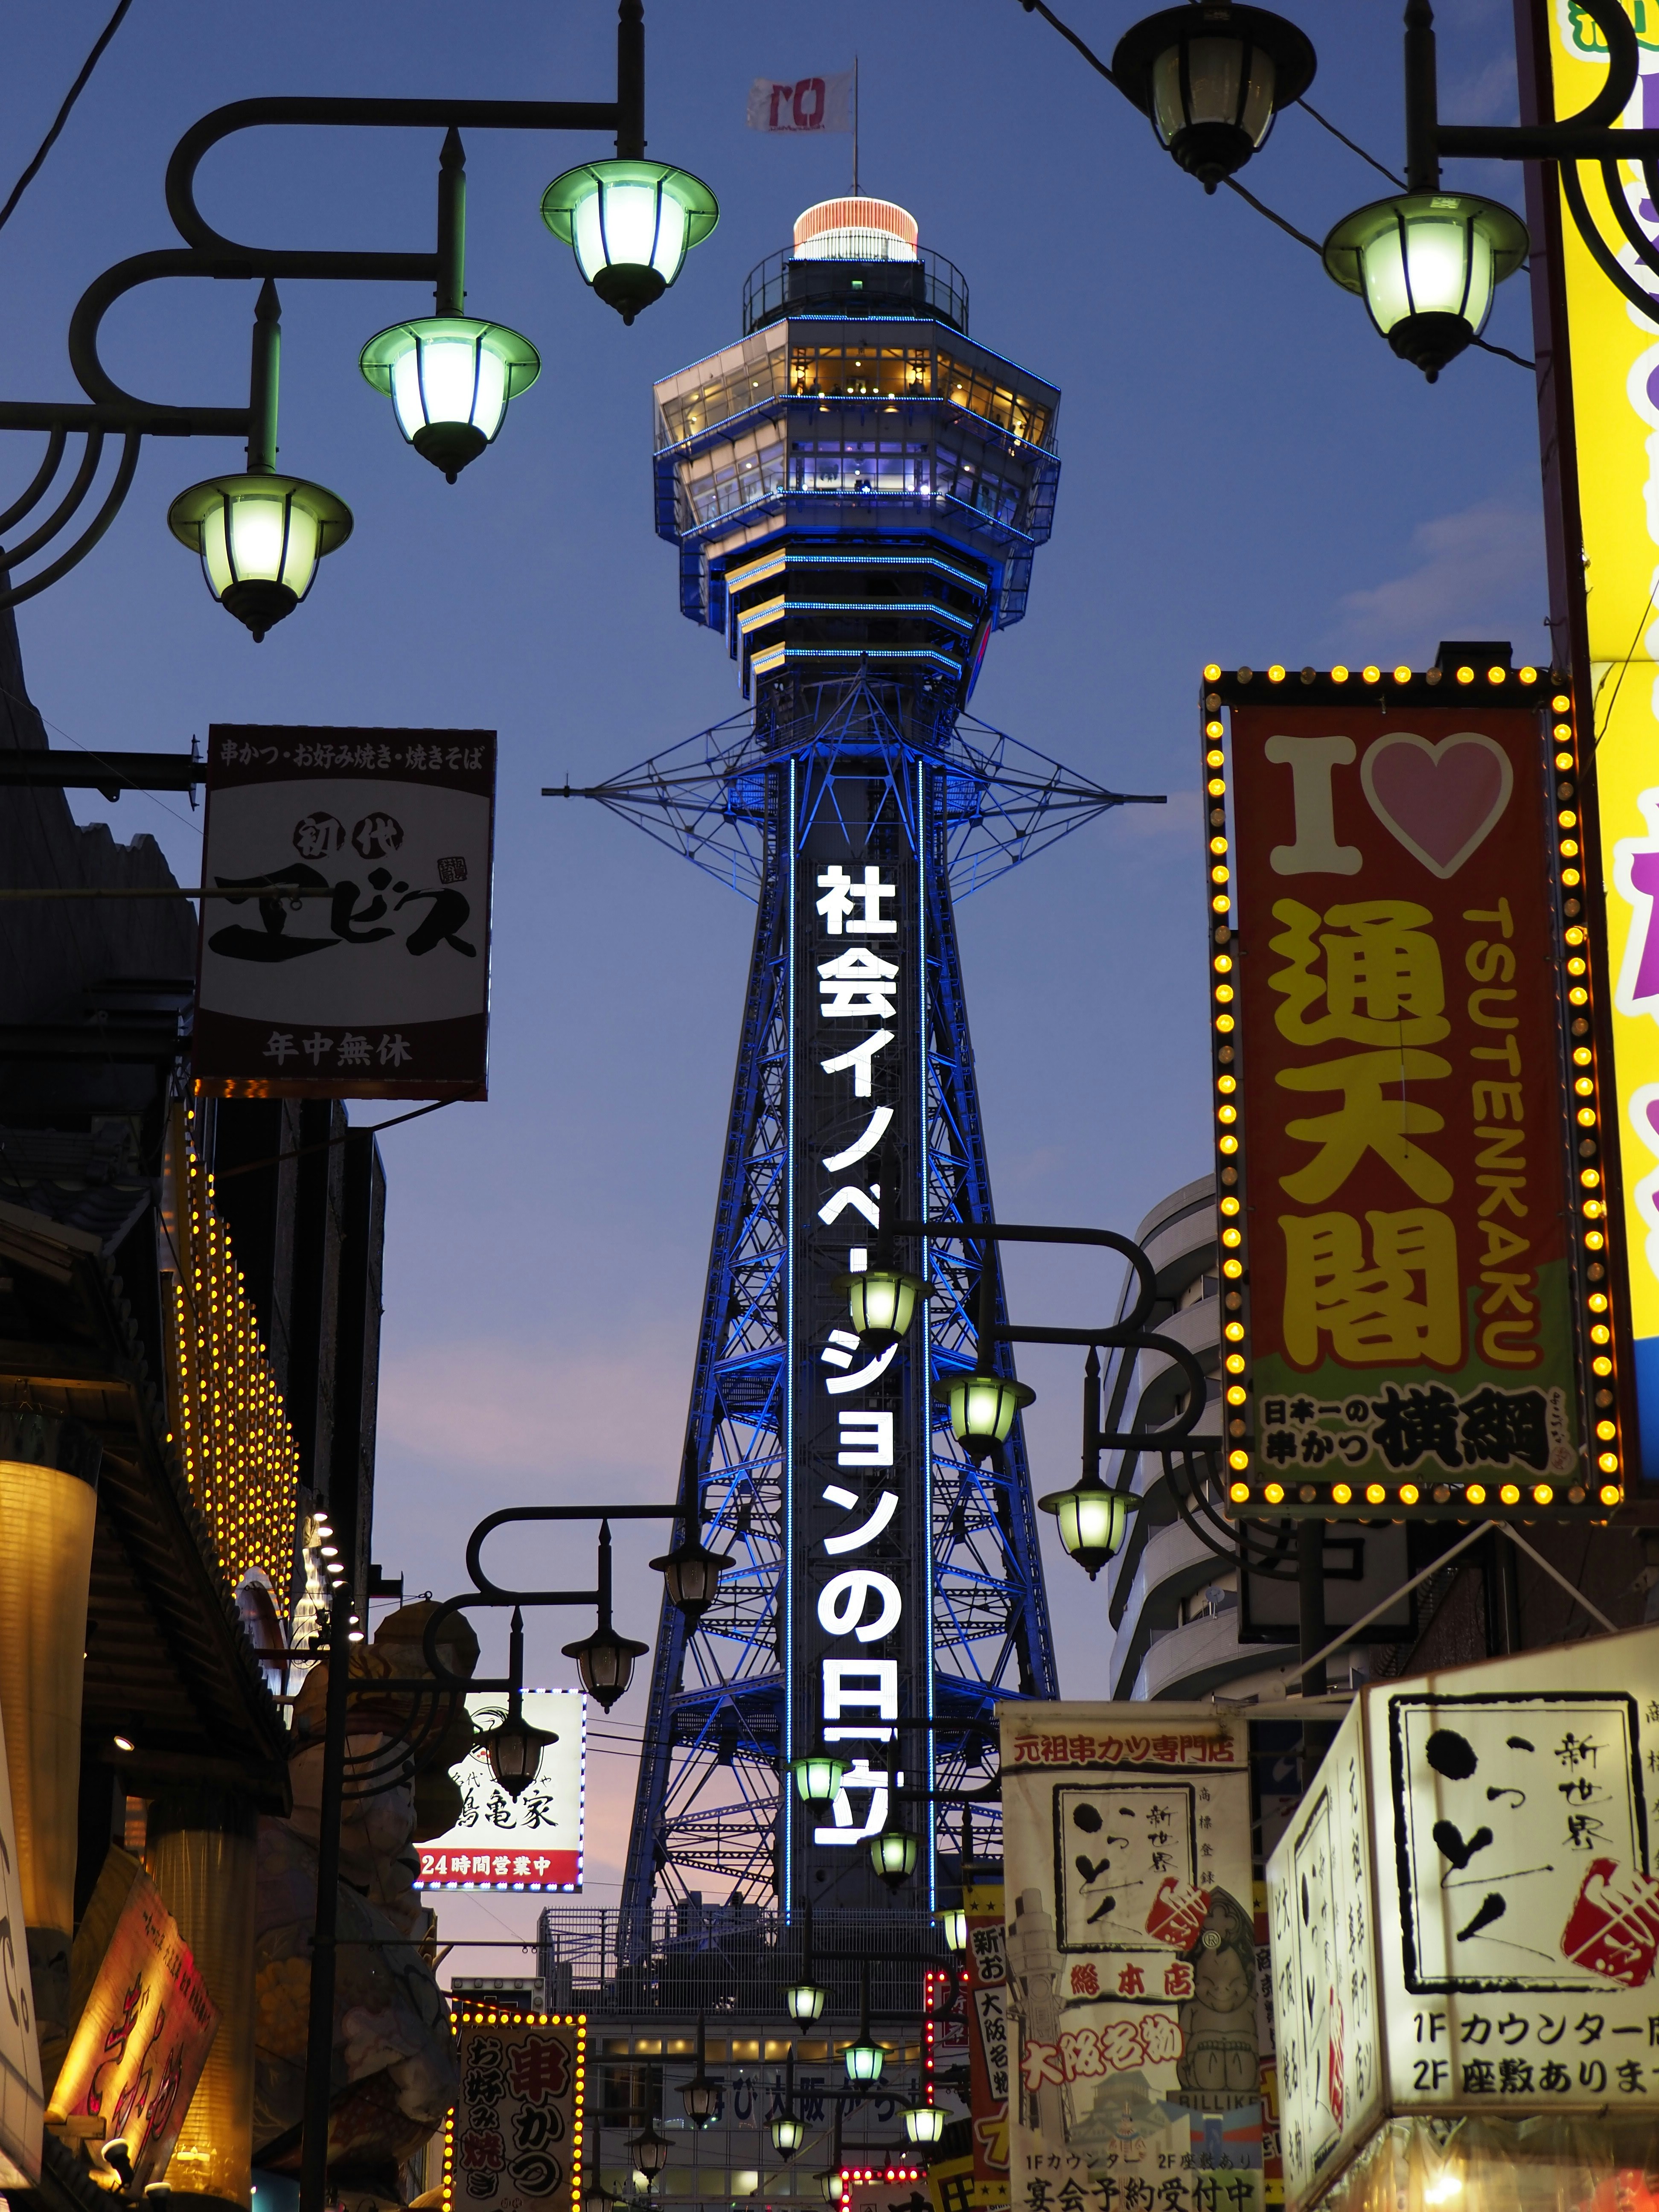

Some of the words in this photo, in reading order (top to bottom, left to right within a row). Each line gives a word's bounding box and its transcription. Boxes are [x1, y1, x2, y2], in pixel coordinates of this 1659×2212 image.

[219, 738, 486, 771] 串かつ・お好み焼き・焼きそば
[208, 862, 477, 963] エビス
[262, 1030, 413, 1068] 年中無休
[1266, 897, 1464, 1365] 通天閣
[1461, 896, 1537, 1362] TSUTENKAKU
[1265, 1398, 1368, 1424] 日本一の
[1266, 1429, 1368, 1464] 串かつ
[1013, 1734, 1234, 1763] 元祖串カツ専門店
[422, 1854, 551, 1877] 24時間営業中
[1020, 2013, 1185, 2092] 大阪名物
[461, 2035, 506, 2199] お好み焼き
[504, 2033, 571, 2198] 串かつ
[1023, 2176, 1255, 2212] 宴会予約受付中
